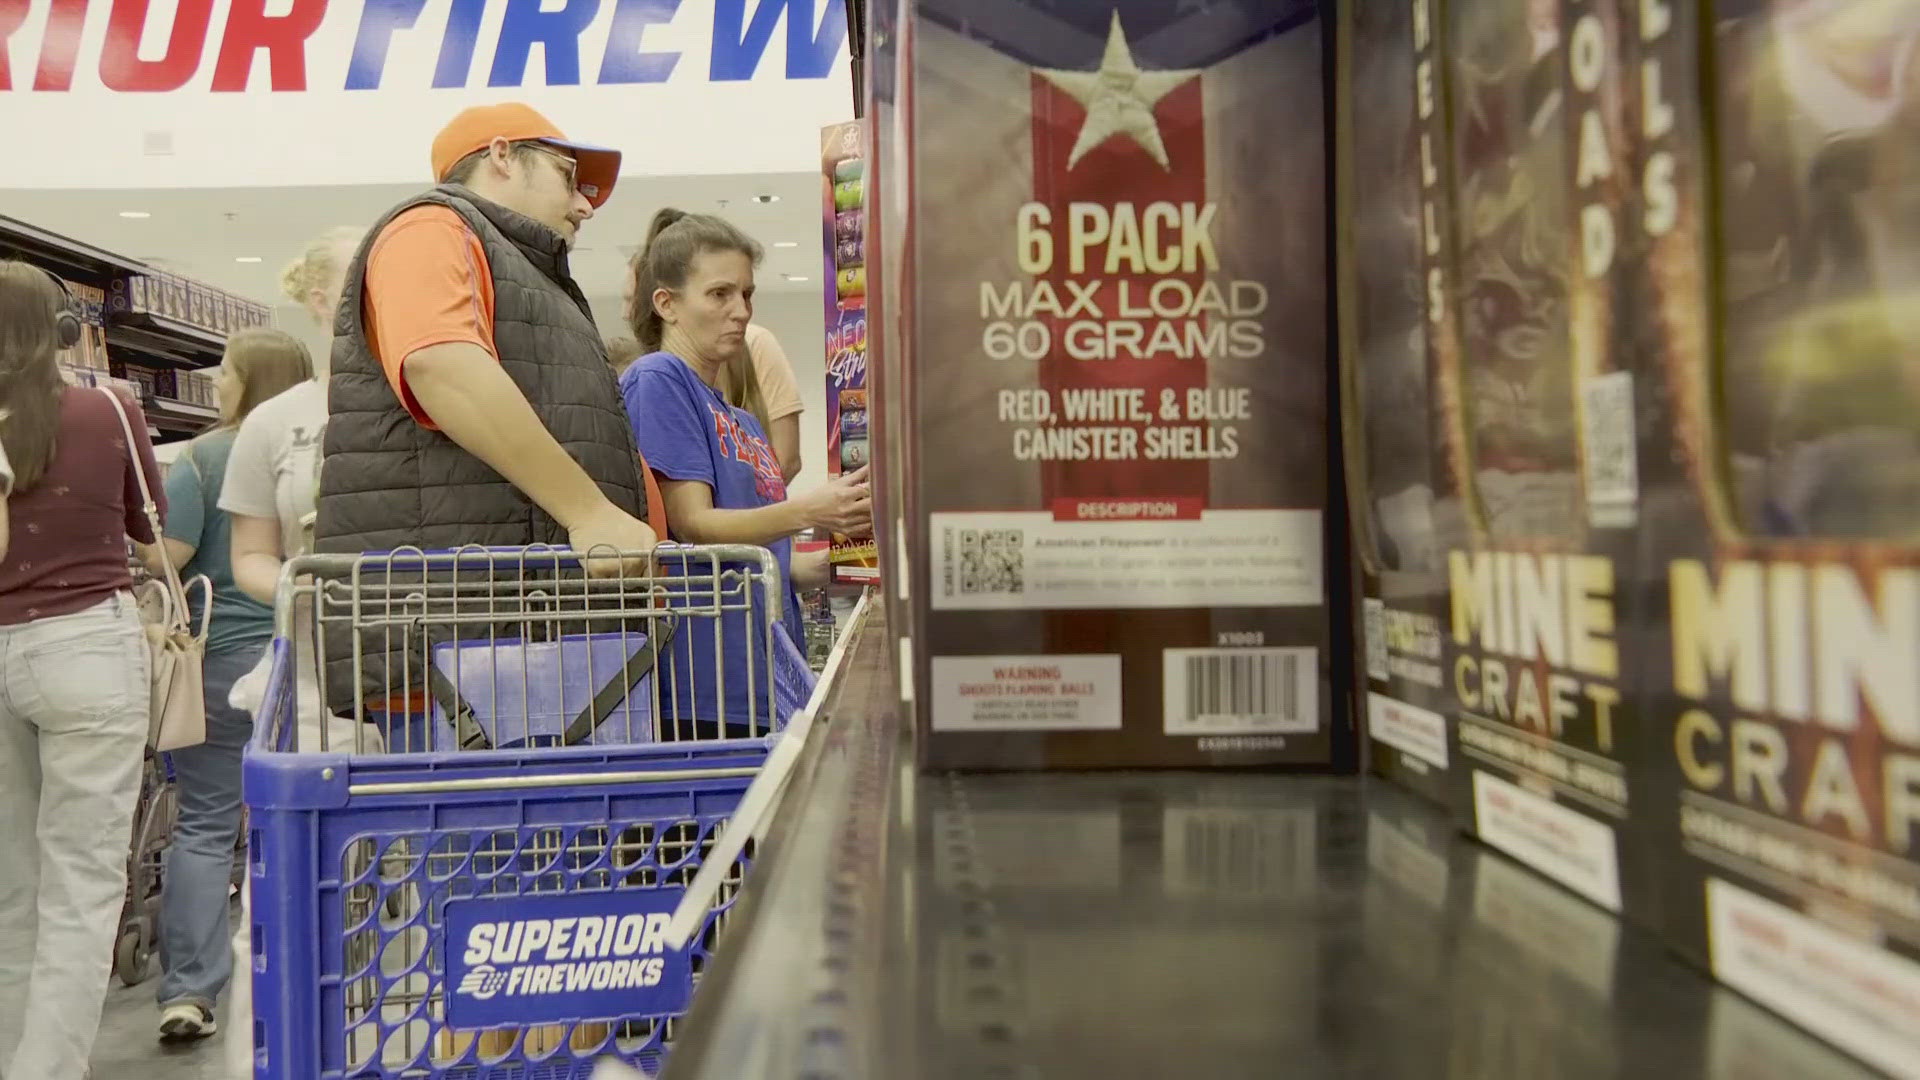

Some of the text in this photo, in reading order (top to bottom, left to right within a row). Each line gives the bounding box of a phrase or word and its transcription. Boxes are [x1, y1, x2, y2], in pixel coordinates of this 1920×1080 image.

[0, 0, 328, 92] IOR
[1569, 0, 1616, 278] OAD
[1016, 201, 1221, 275] 6 PACK
[979, 279, 1270, 319] MAX LOAD
[982, 320, 1266, 360] 60 GRAMS
[999, 387, 1252, 425] RED, WHITE, & BLUE
[1012, 426, 1240, 462] CANISTER SHELLS
[1076, 501, 1178, 519] DESCRIPTION
[1449, 550, 1620, 678] MINE
[992, 666, 1062, 682] WARNING
[1669, 558, 1920, 750] MIN
[1454, 654, 1620, 753] CRAFT
[463, 912, 673, 966] SUPERIOR
[505, 958, 665, 997] FIREWORKS
